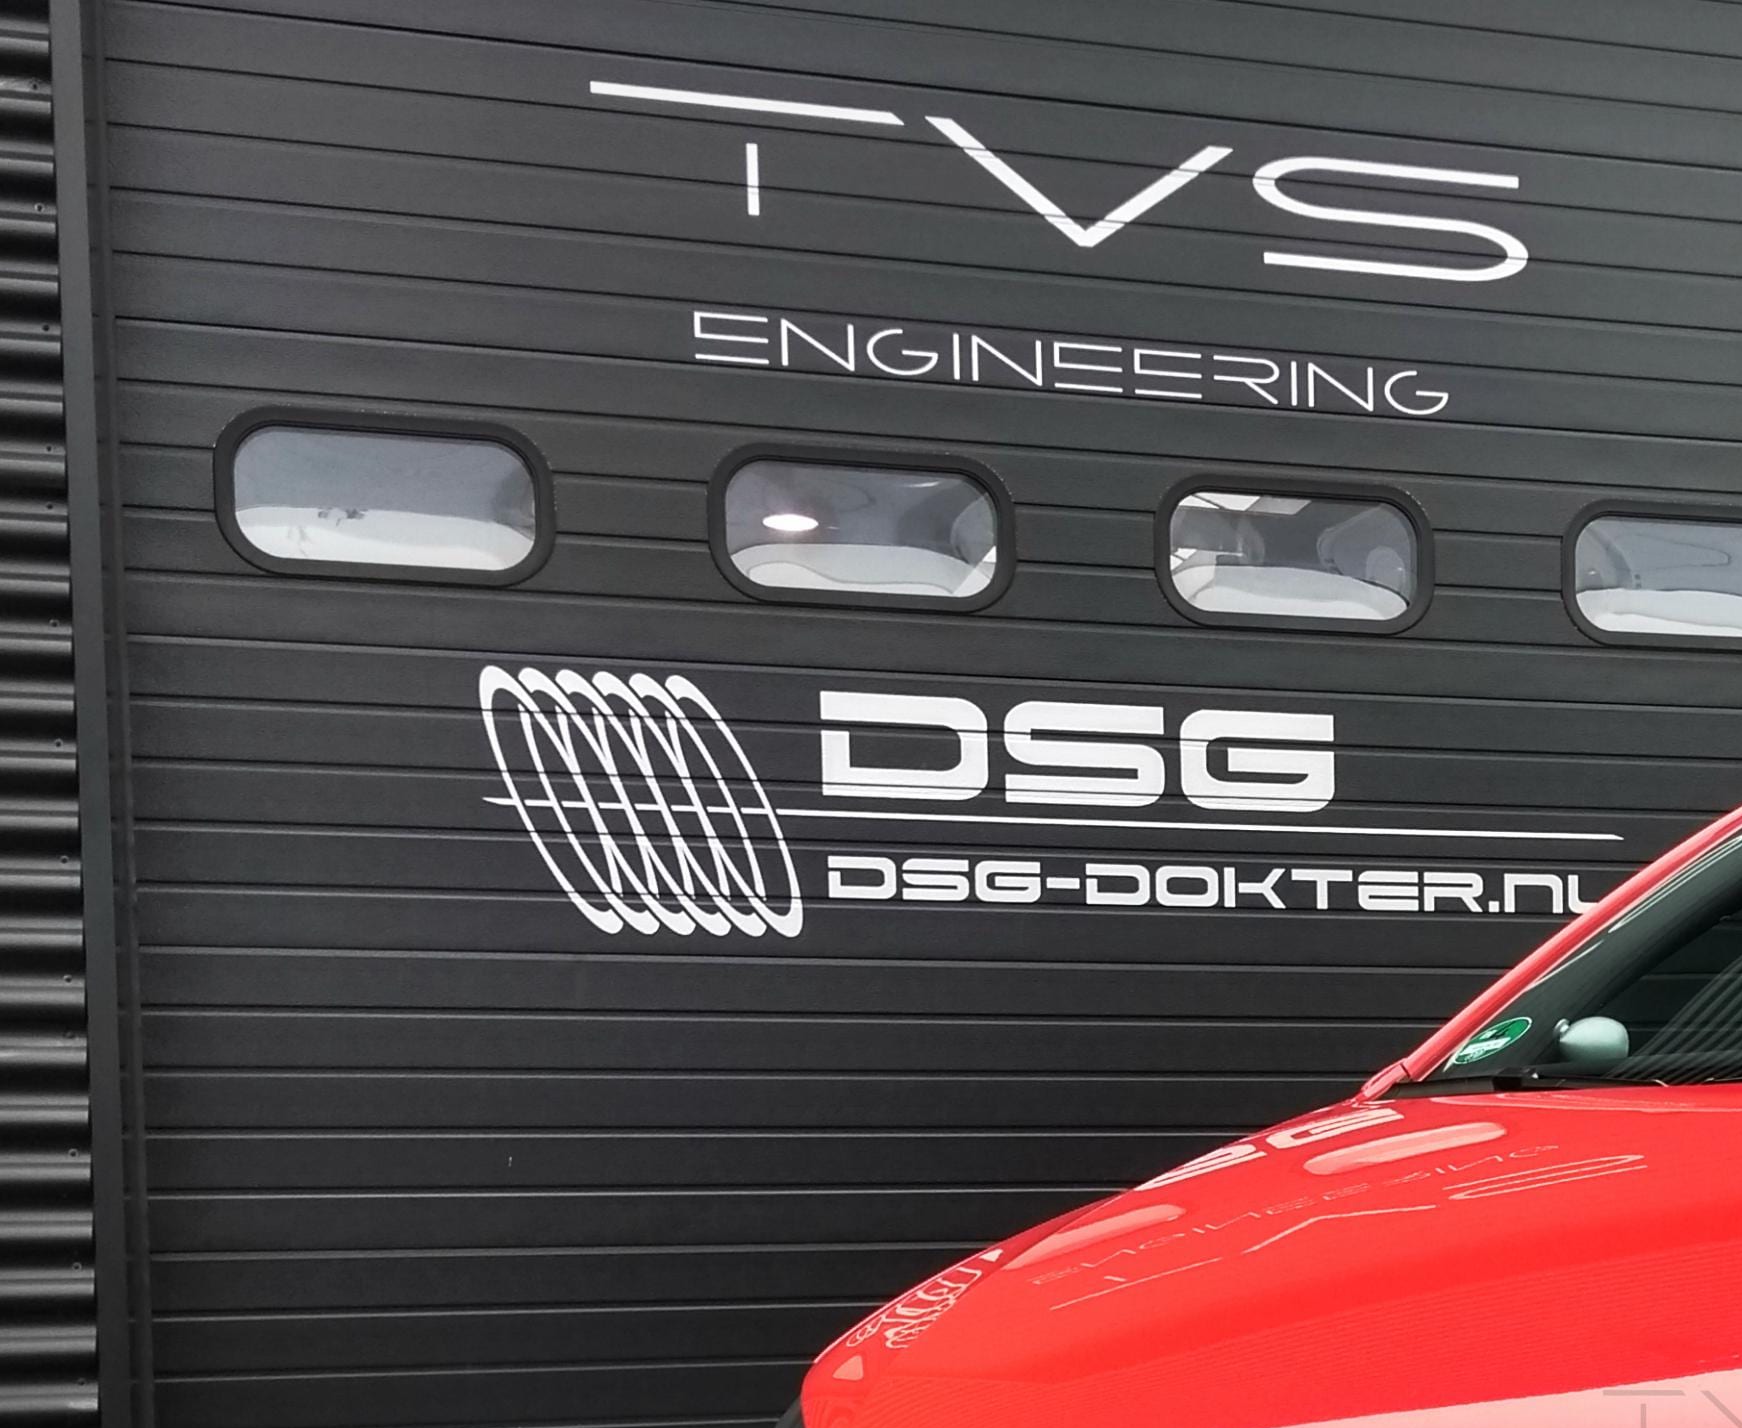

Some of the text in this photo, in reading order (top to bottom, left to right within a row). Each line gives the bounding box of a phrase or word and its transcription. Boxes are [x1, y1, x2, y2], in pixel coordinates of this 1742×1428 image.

[588, 80, 1529, 282] TVS
[693, 310, 1449, 416] ENGINEERING
[819, 689, 1336, 813] DSG
